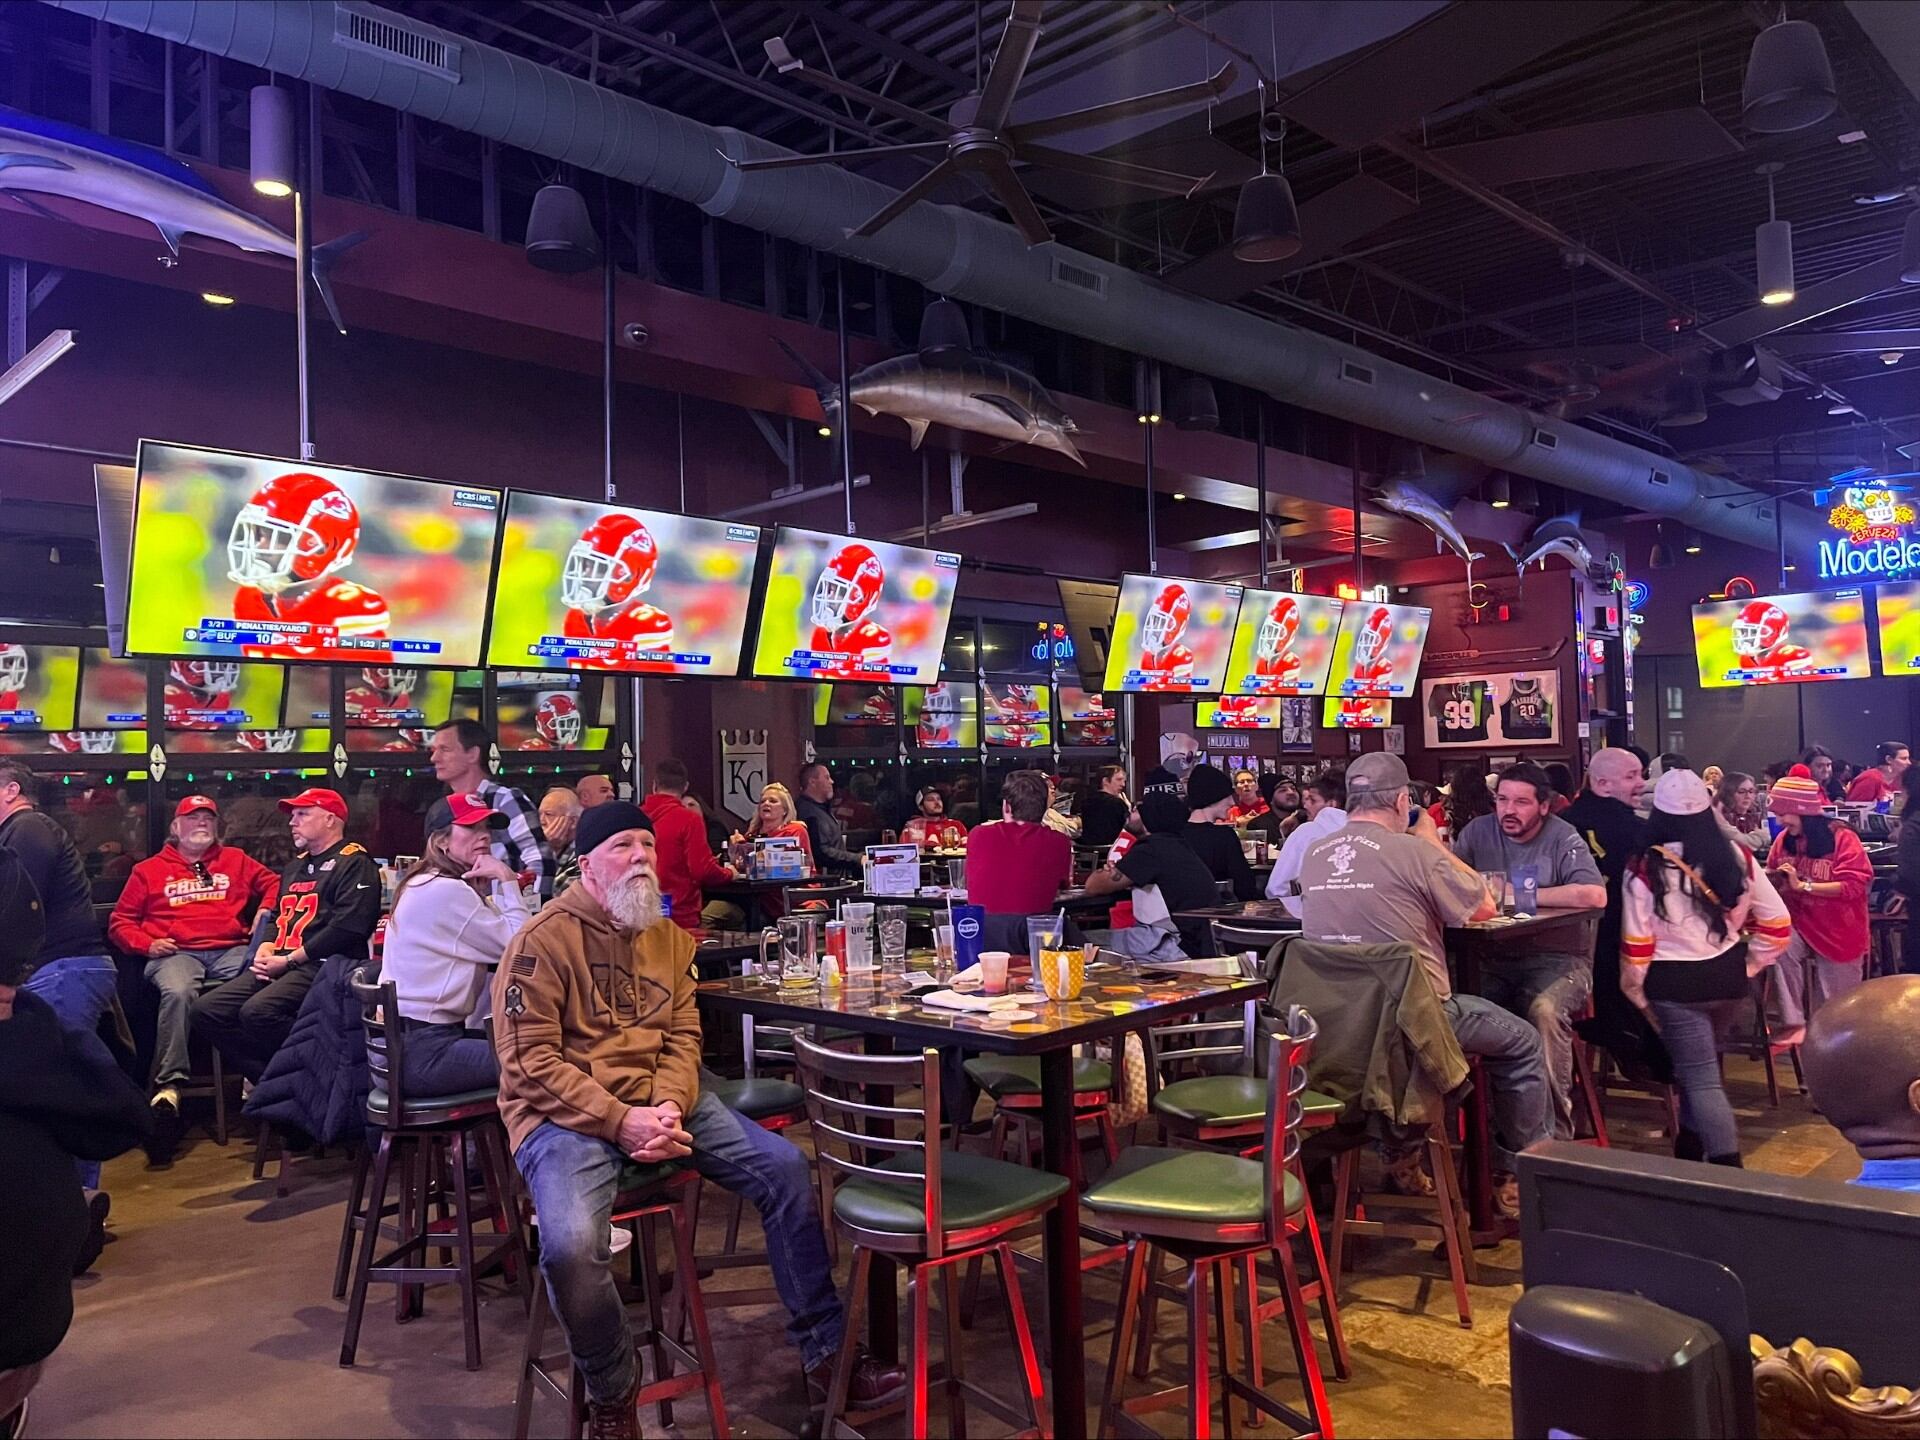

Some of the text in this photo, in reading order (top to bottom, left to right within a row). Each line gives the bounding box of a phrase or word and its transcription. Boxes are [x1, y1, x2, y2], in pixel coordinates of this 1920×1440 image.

[1849, 527, 1896, 544] CERVEZA
[236, 622, 308, 633] PENALTIES/YARDS
[216, 632, 237, 641] BUF
[256, 634, 270, 644] 10
[323, 637, 337, 648] 21
[578, 649, 588, 657] 10
[625, 652, 636, 660] 21
[1444, 699, 1476, 729] 39
[1520, 704, 1536, 716] 20
[728, 760, 763, 804] KC
